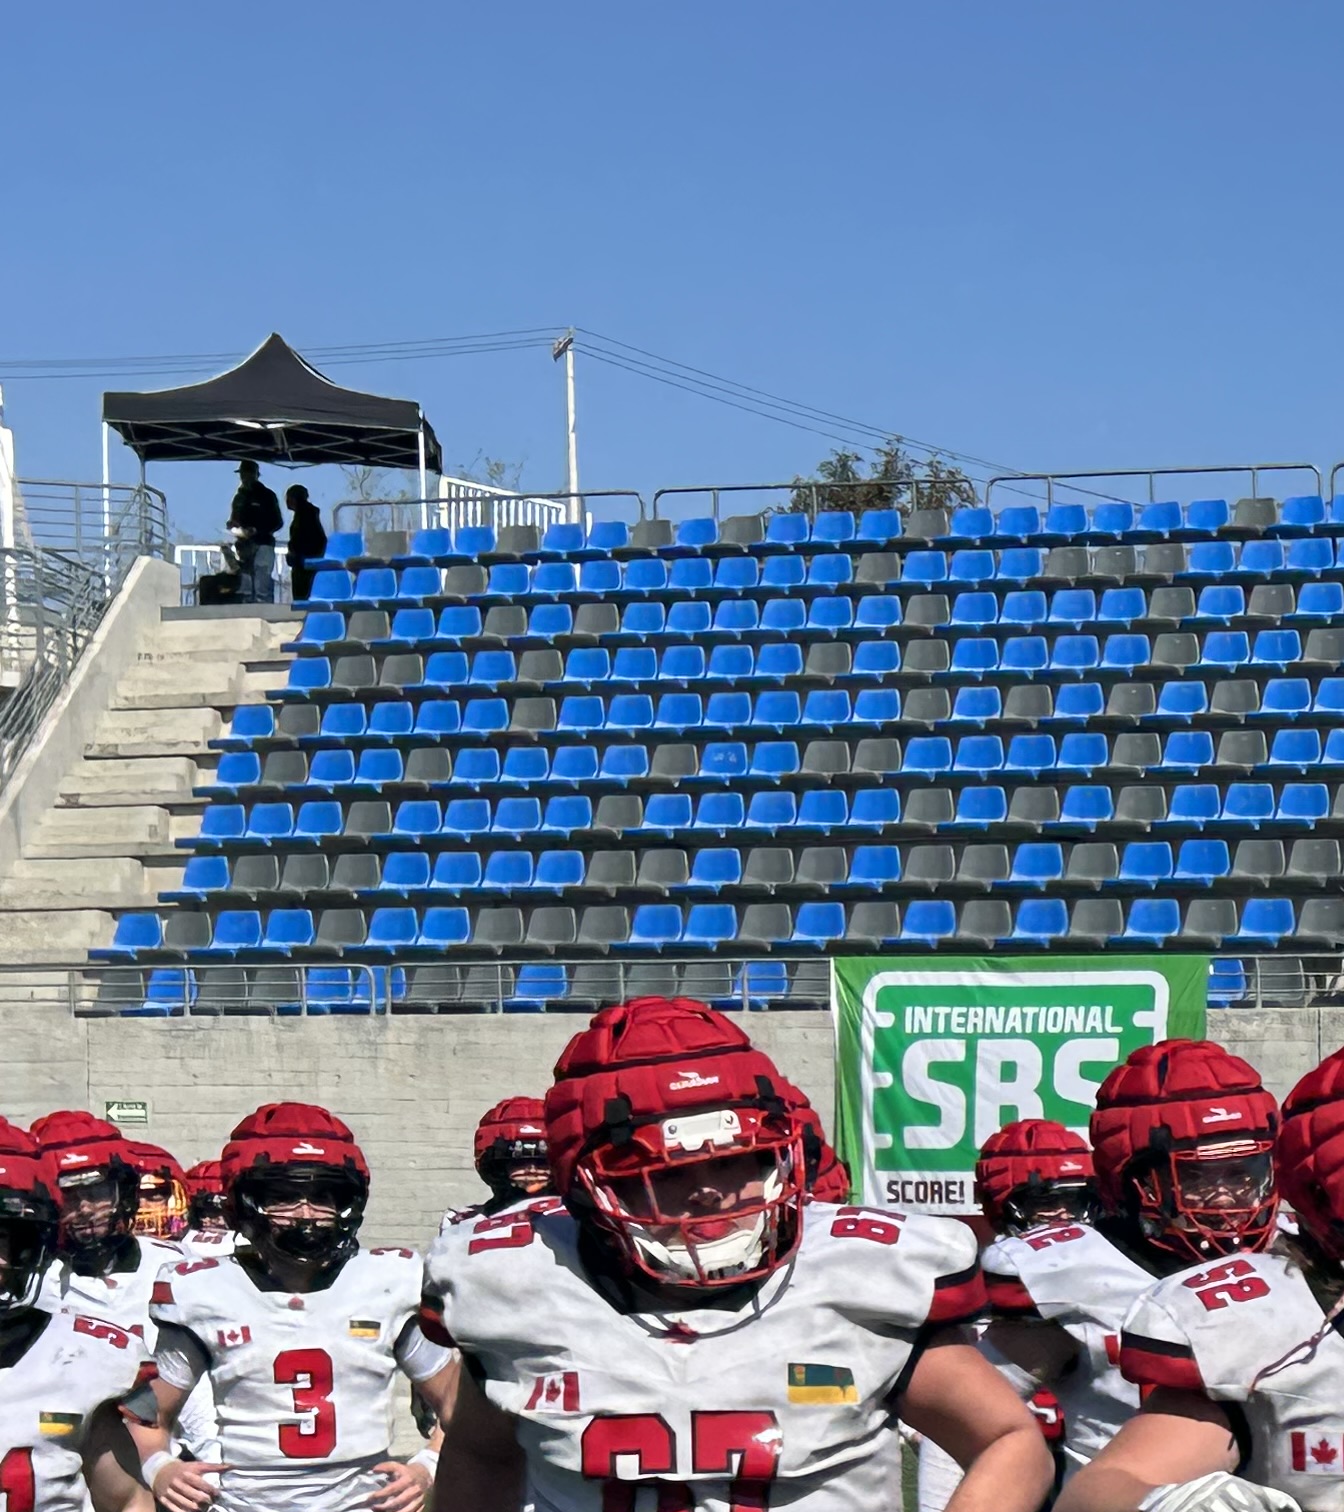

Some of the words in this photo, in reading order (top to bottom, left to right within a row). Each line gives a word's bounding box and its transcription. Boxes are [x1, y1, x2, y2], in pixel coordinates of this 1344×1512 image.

[904, 1005, 1123, 1034] INTERNATIONAL
[902, 1037, 1120, 1151] SBS
[886, 1180, 965, 1205] SCORE!
[1182, 1258, 1273, 1312] 52
[273, 1348, 338, 1459] 3
